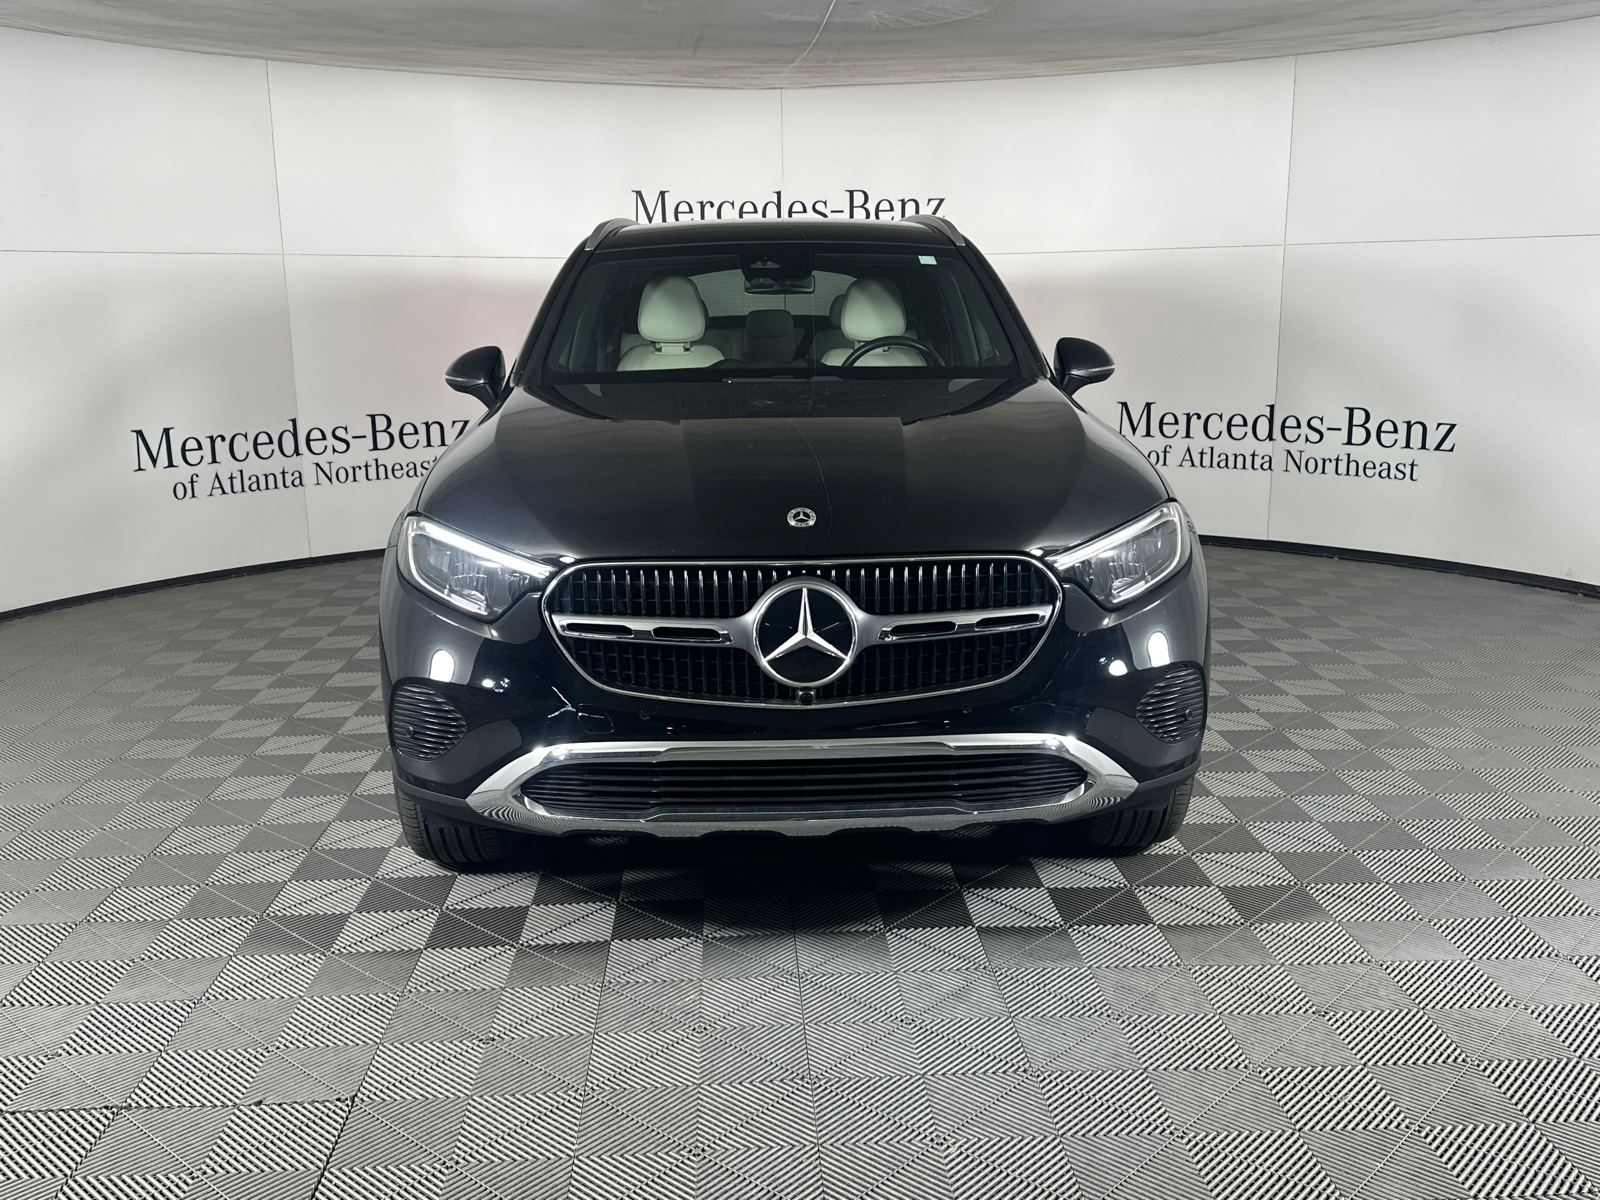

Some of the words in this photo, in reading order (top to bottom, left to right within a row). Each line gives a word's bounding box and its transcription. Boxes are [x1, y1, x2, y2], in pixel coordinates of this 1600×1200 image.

[631, 189, 946, 224] Mercedes-Benz
[131, 413, 470, 472] Mercedes-Benz
[1117, 401, 1457, 452] Mercedes-Benz
[1147, 444, 1172, 466] of
[1178, 445, 1273, 471] Atlanta
[1283, 449, 1419, 482] Northeast
[172, 473, 199, 500] of
[207, 466, 305, 497] Atlanta
